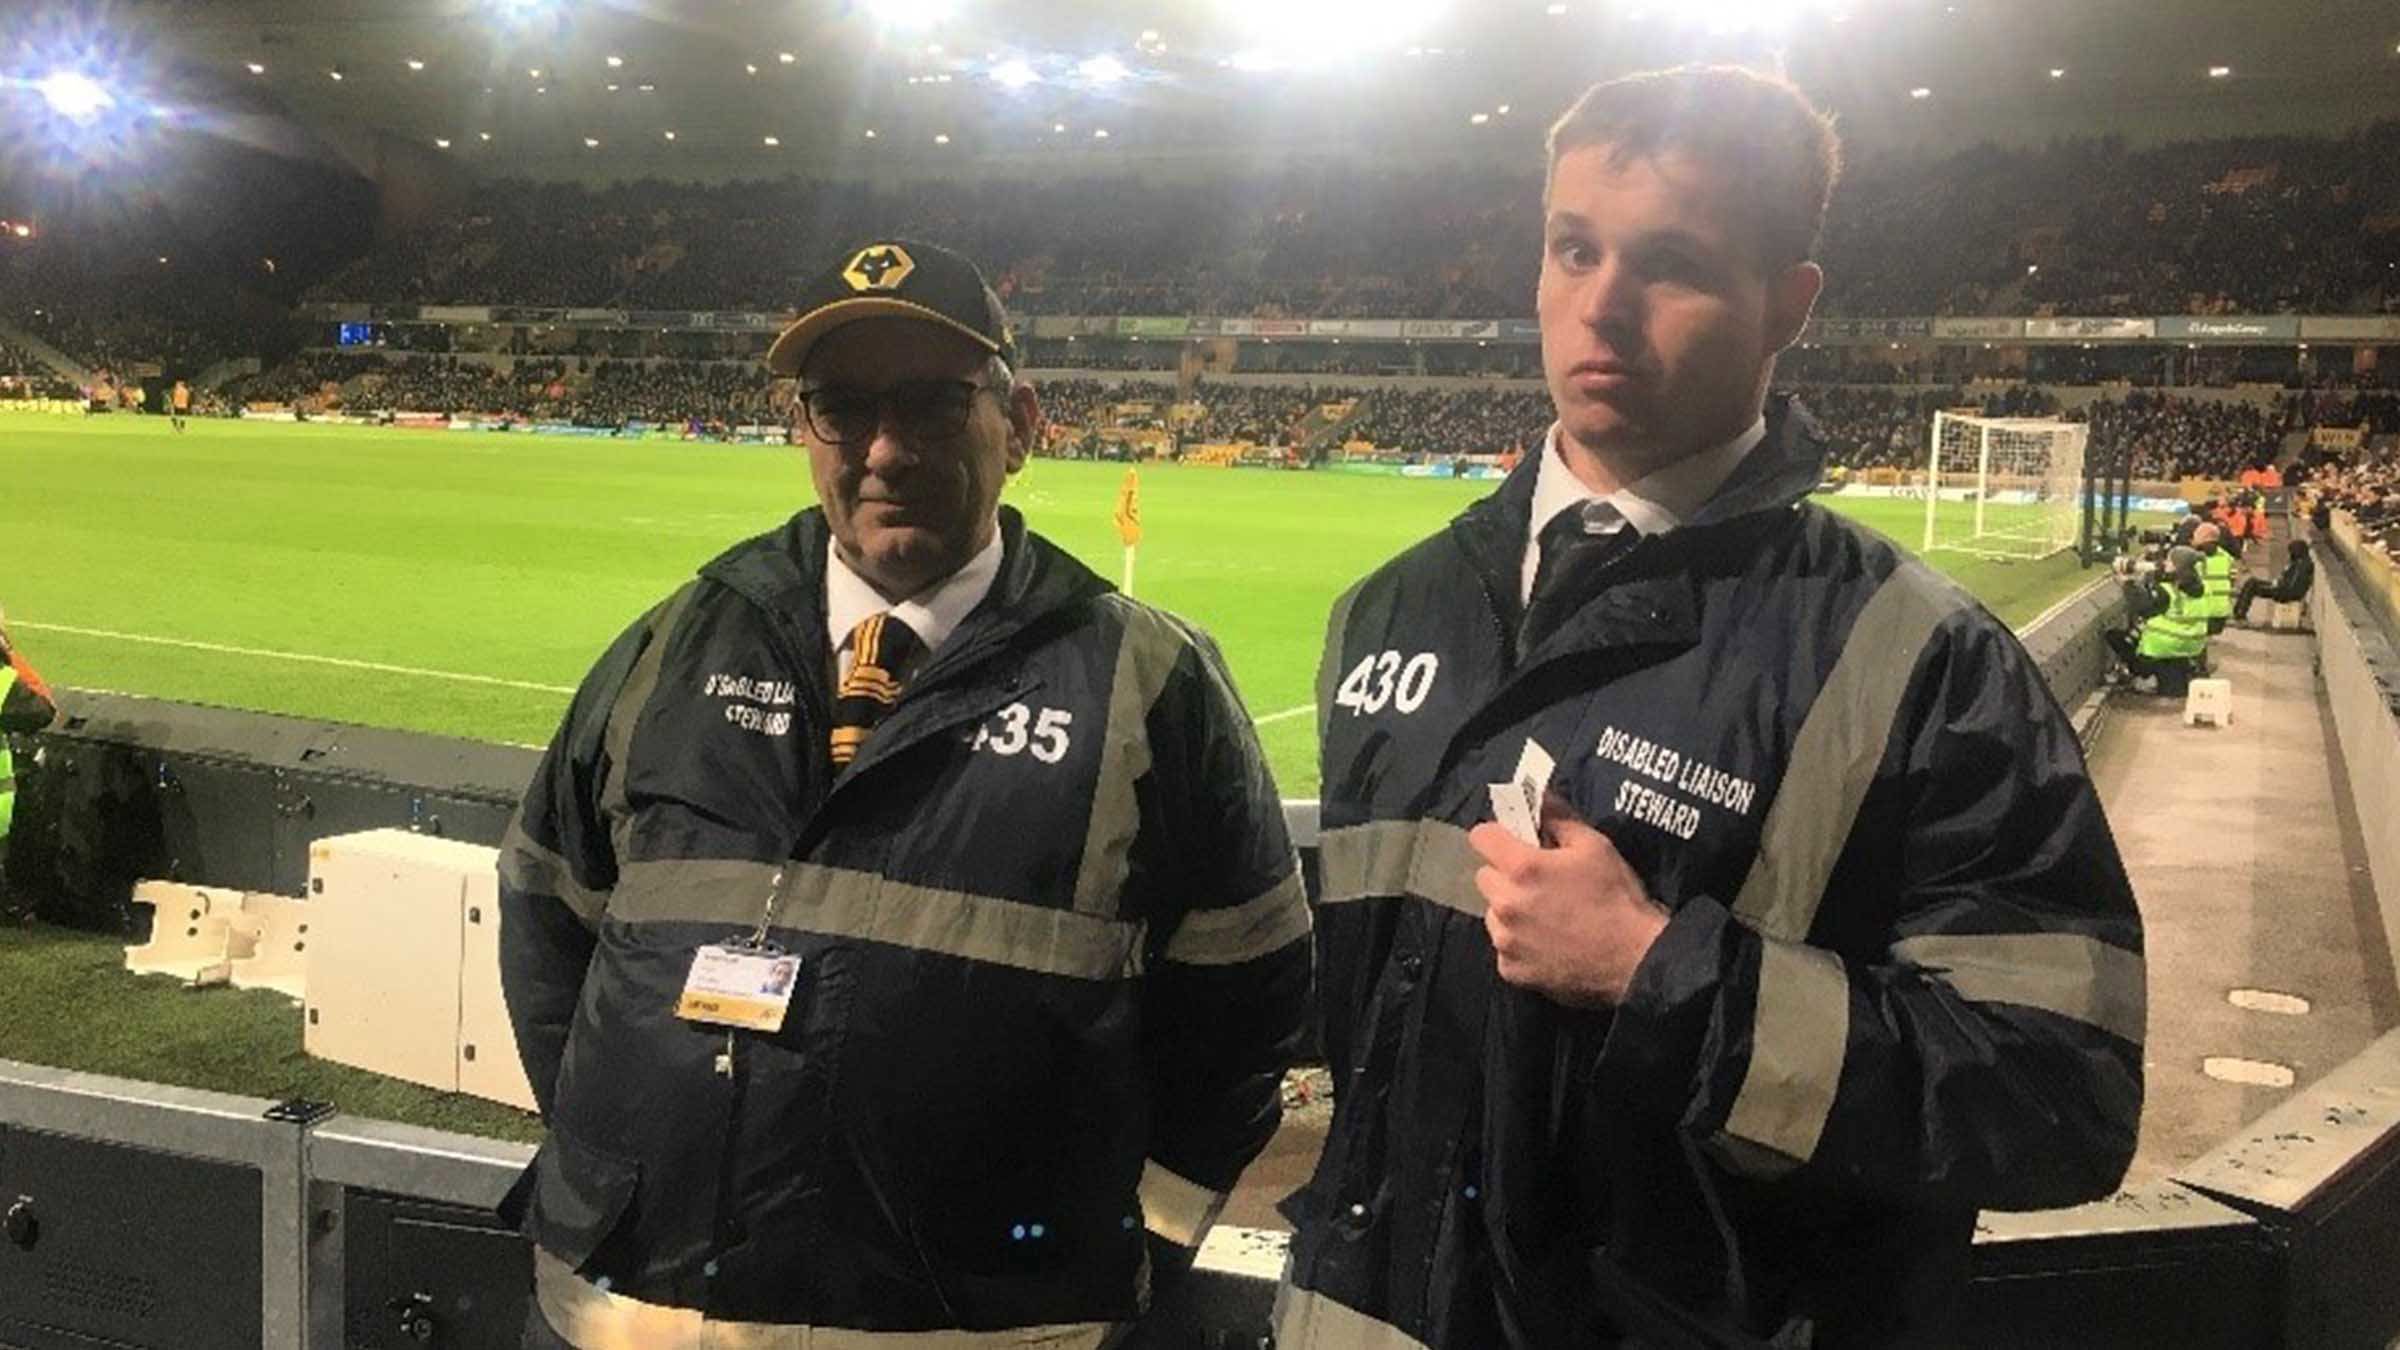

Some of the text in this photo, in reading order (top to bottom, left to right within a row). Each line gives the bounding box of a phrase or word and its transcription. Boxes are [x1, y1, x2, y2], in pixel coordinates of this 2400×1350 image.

[1336, 650, 1439, 716] 430
[1597, 725, 1756, 814] DISABLED LIAISON
[1615, 779, 1700, 840] STEWARD
